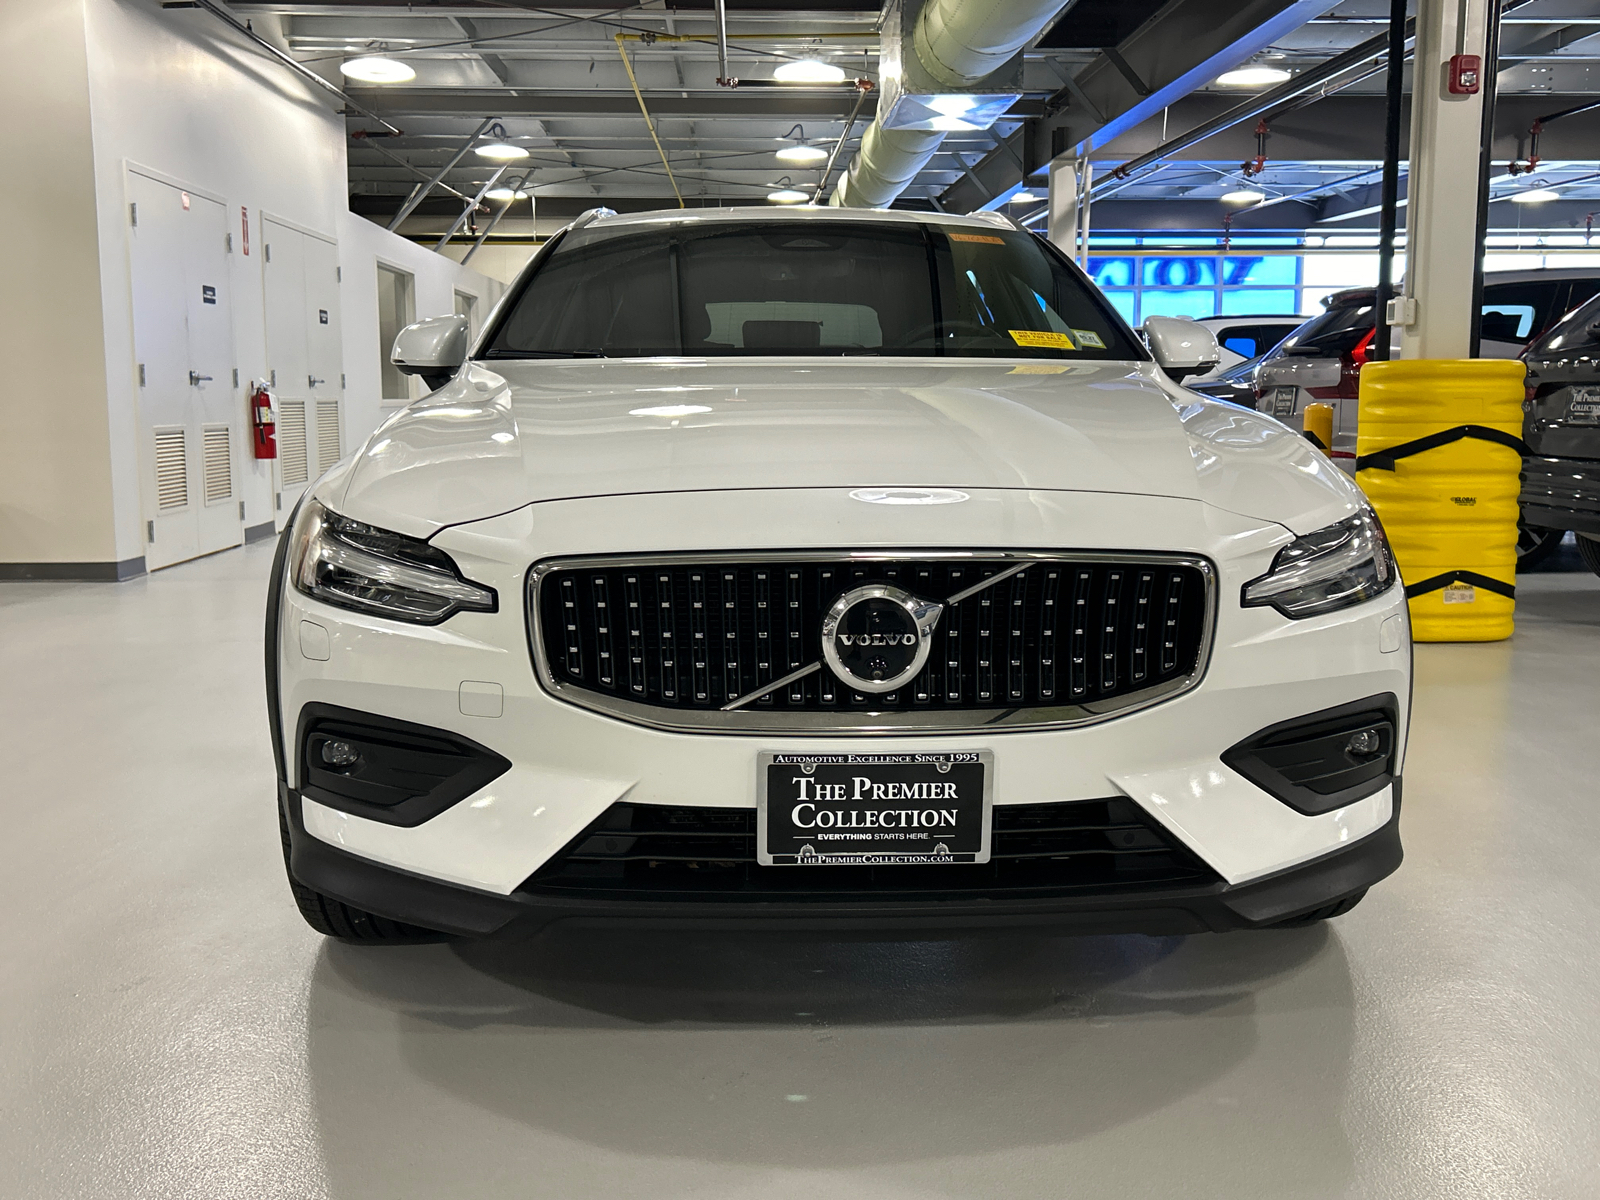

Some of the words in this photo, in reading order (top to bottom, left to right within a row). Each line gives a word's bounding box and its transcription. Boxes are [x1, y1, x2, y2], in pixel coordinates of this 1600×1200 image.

[1542, 359, 1600, 369] VOLV
[838, 634, 917, 646] VOLVO
[775, 754, 844, 763] AUTOMOTIVE
[847, 754, 912, 763] EXCELLENCE
[914, 754, 946, 763] SINCE
[949, 753, 978, 762] 1995
[792, 776, 847, 801] THE
[851, 777, 959, 800] PREMIER
[791, 803, 959, 828] COLLECTION
[906, 832, 931, 840] HERE.
